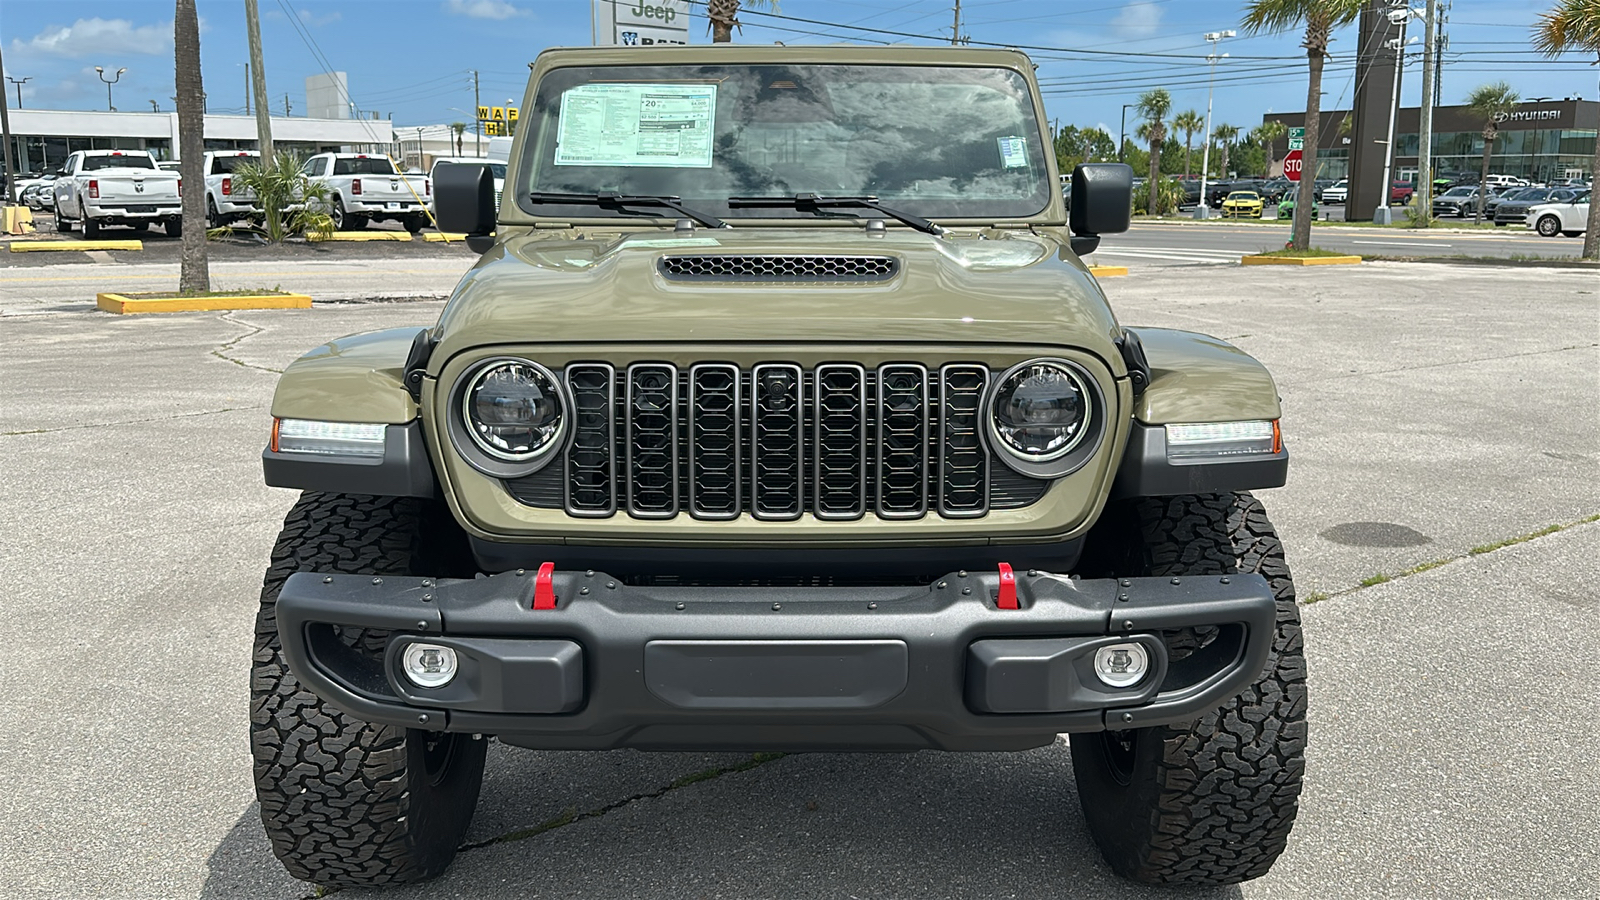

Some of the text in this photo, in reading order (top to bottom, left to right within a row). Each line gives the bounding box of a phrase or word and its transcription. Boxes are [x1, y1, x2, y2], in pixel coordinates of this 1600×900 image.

[631, 0, 676, 24] Jeep
[479, 108, 517, 119] WAF
[1510, 110, 1561, 121] HYUNDAI
[1285, 159, 1302, 172] STO
